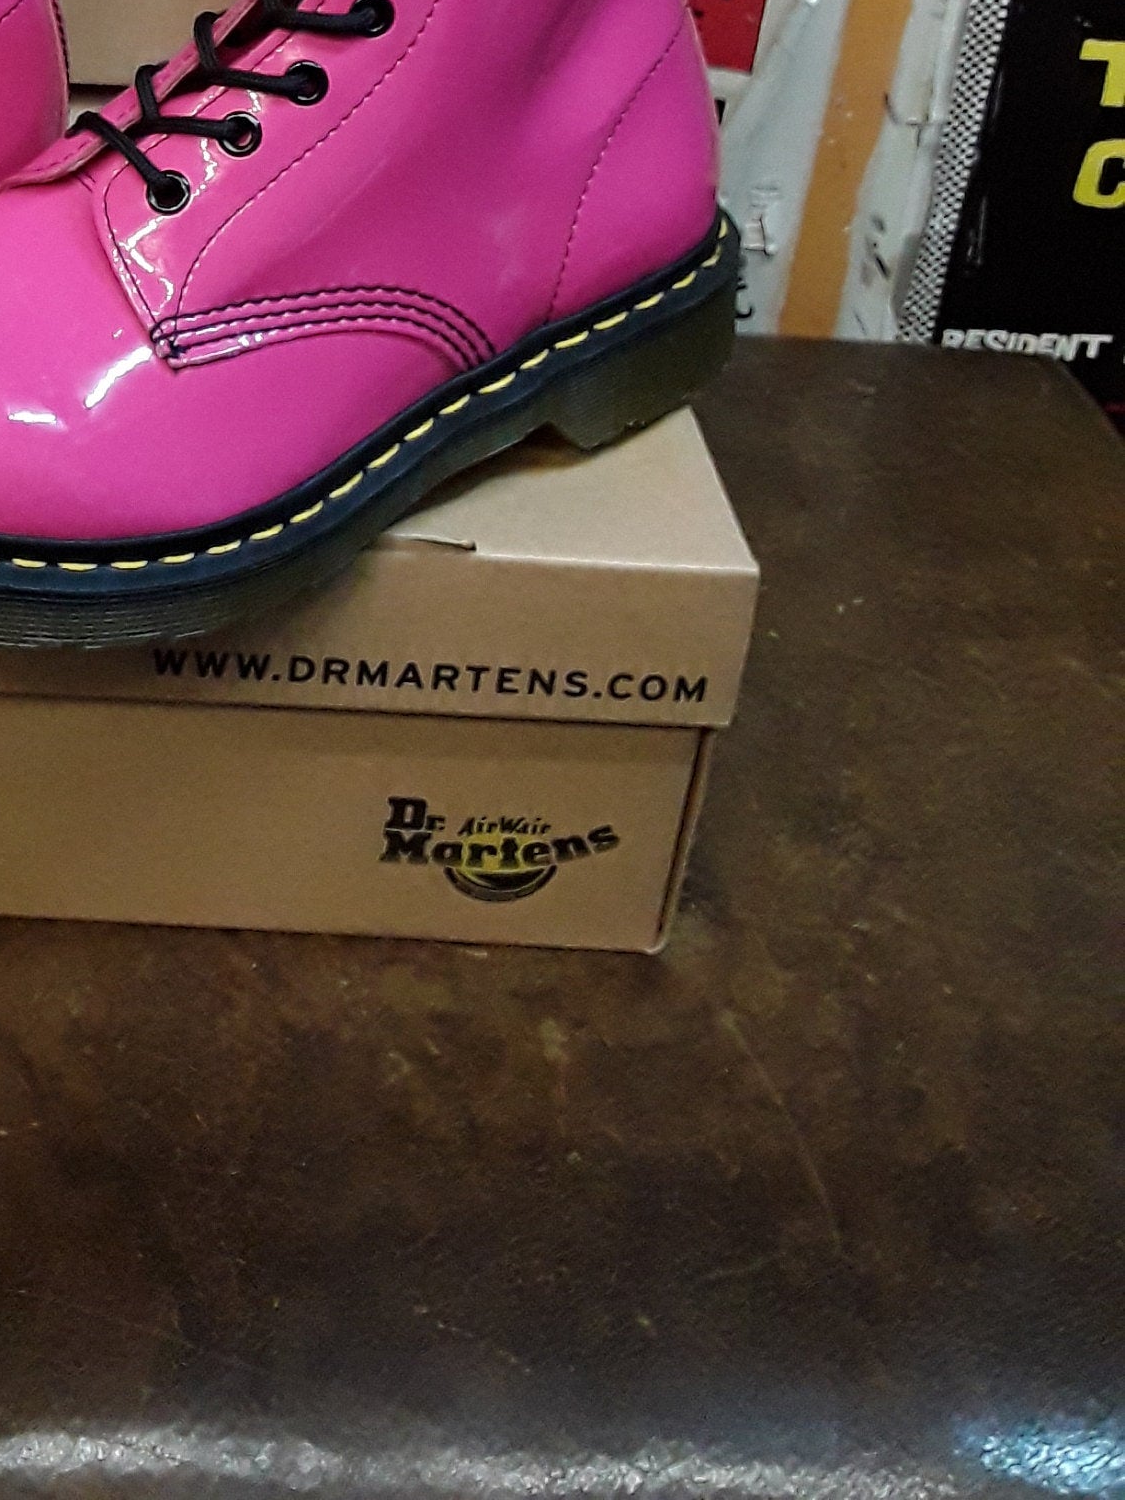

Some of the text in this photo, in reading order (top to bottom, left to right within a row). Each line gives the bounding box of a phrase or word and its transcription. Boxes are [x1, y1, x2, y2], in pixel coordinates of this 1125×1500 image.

[941, 328, 1114, 362] RESIDENT
[153, 649, 709, 703] WWW.DRMARTENS.COM
[378, 824, 621, 865] Martens
[457, 815, 553, 837] AirWair
